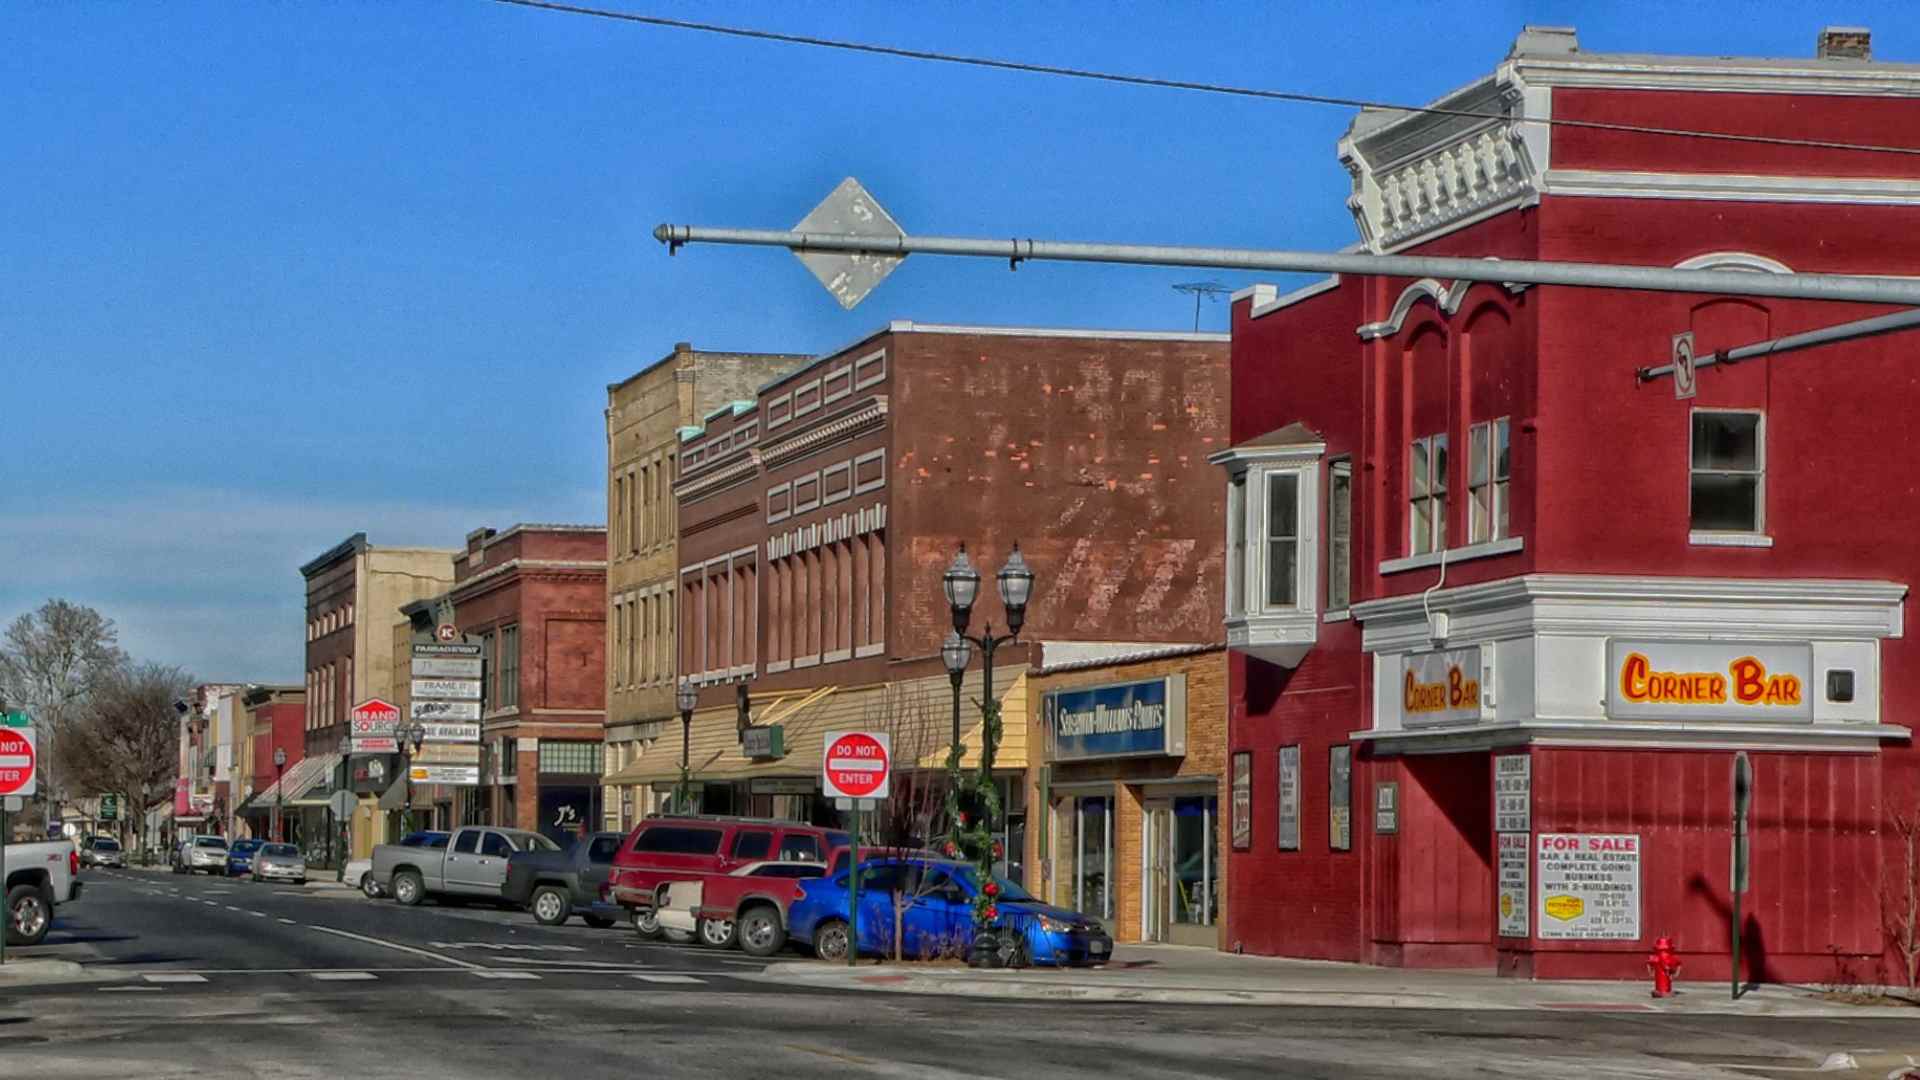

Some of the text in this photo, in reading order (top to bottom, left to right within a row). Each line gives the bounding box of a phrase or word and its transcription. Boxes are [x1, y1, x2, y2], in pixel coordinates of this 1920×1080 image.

[1621, 652, 1802, 705] CORNER BAR
[1404, 664, 1478, 712] CORNER BAR
[355, 711, 397, 720] BRAND
[439, 727, 478, 736] AVAILABLE
[1, 741, 25, 752] NOT
[837, 745, 877, 756] DO NOT
[0, 770, 20, 781] TER
[839, 773, 873, 784] ENTER
[1543, 838, 1636, 851] FOR SALE
[1602, 853, 1638, 861] ESTATE
[1546, 863, 1632, 871] COMPLETE GOING
[1565, 873, 1613, 881] BUSINESS
[1545, 883, 1569, 891] WITH
